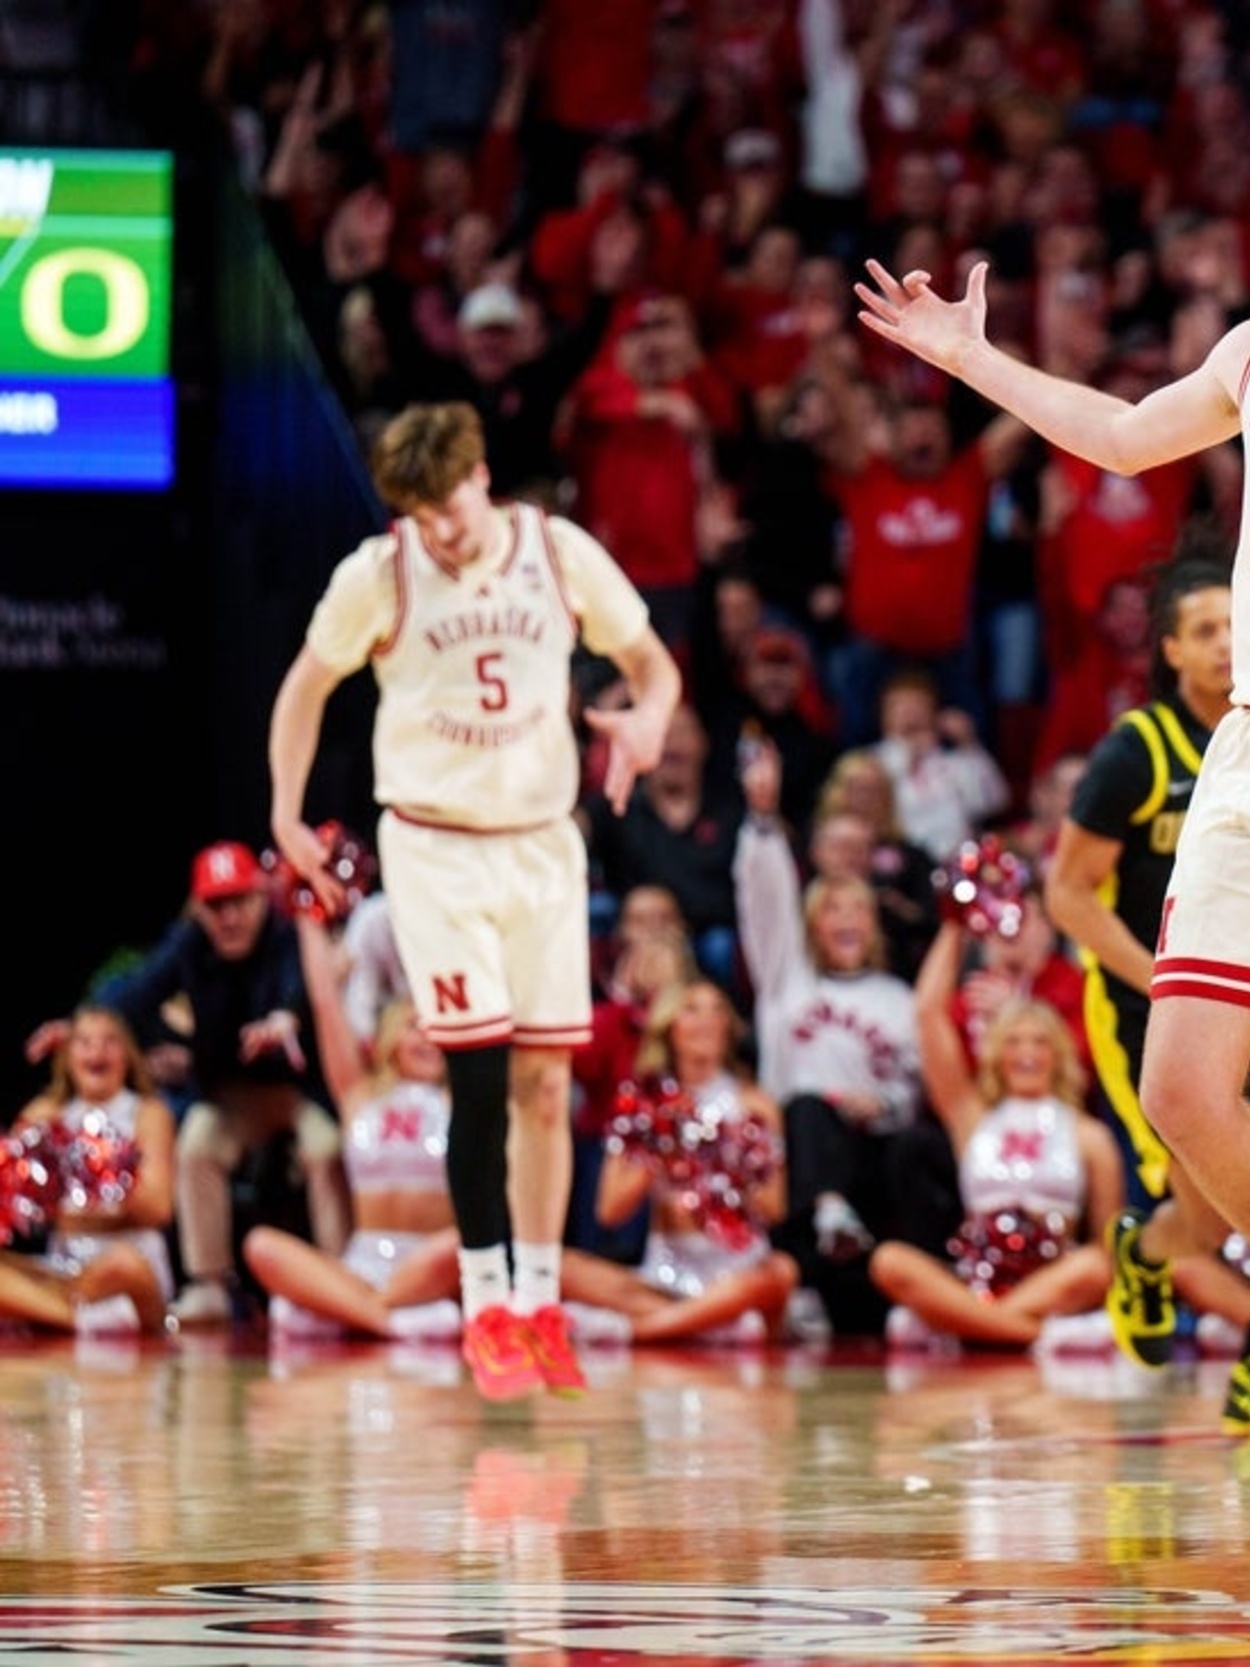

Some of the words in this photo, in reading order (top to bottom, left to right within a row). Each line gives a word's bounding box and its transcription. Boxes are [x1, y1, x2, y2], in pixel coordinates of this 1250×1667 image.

[20, 246, 149, 360] O
[474, 651, 509, 712] 5
[431, 972, 470, 1014] N
